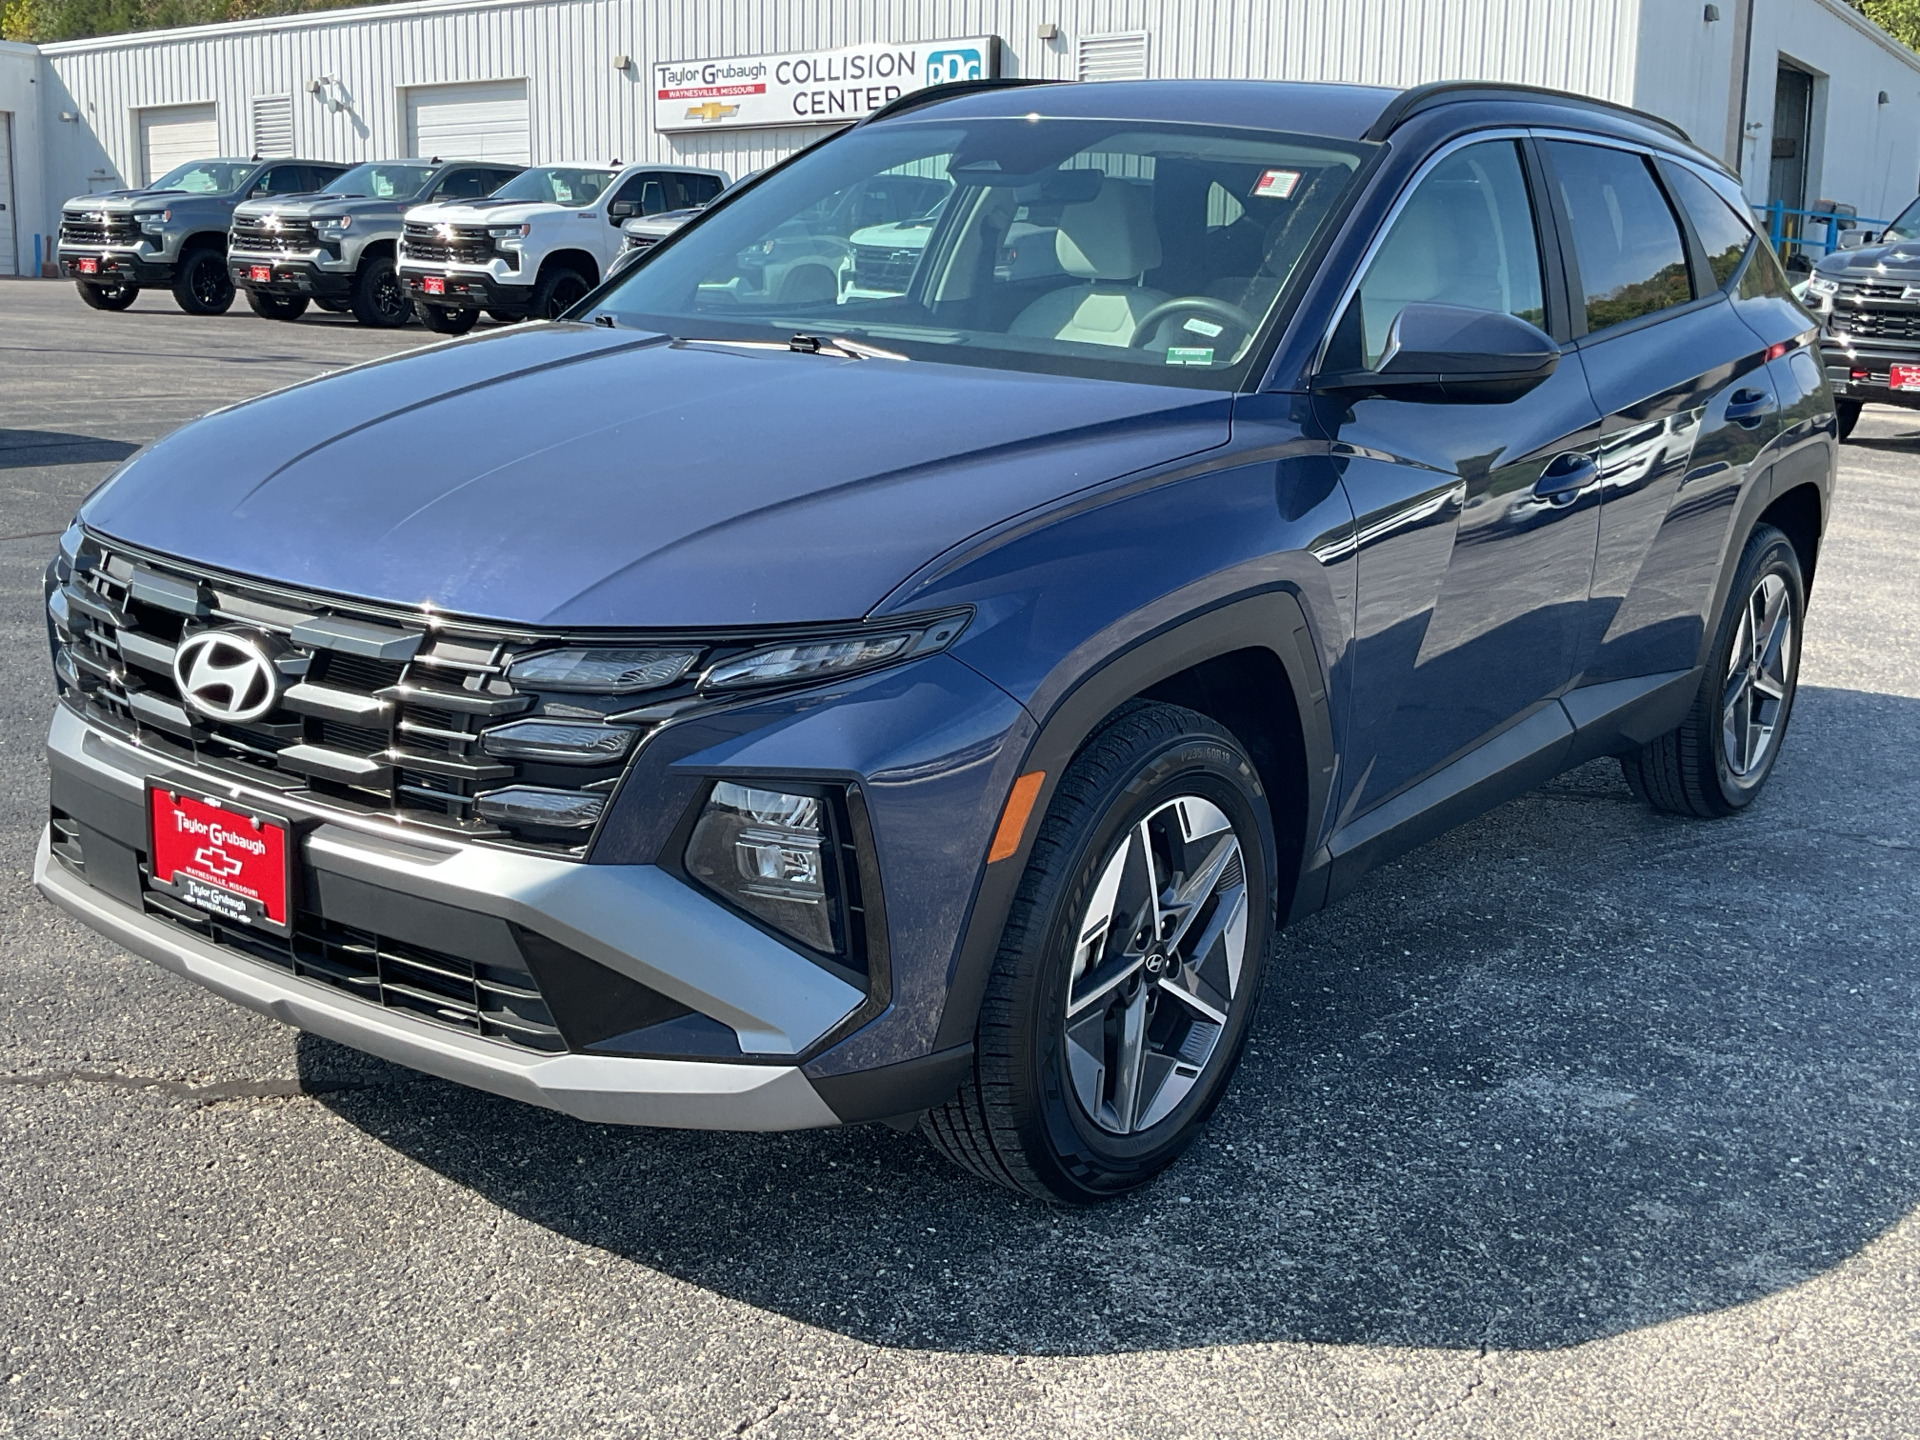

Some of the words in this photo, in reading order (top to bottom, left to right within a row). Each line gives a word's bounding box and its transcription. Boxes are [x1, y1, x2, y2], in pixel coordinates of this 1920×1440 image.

[658, 67, 699, 88] Taylor
[702, 62, 766, 84] Grubaugh
[775, 51, 915, 85] COLLISION
[668, 88, 719, 98] WAYNESVILLE,
[721, 85, 755, 95] MISSOURI
[793, 85, 901, 115] CENTER
[1181, 747, 1230, 764] P235/60R18
[173, 810, 208, 833] Taylor
[209, 823, 265, 855] Grubaugh
[186, 866, 228, 887] WAYNESVILLE,
[229, 881, 258, 898] MISSOURI
[188, 880, 210, 896] Taylor
[210, 889, 247, 911] Grubaugh
